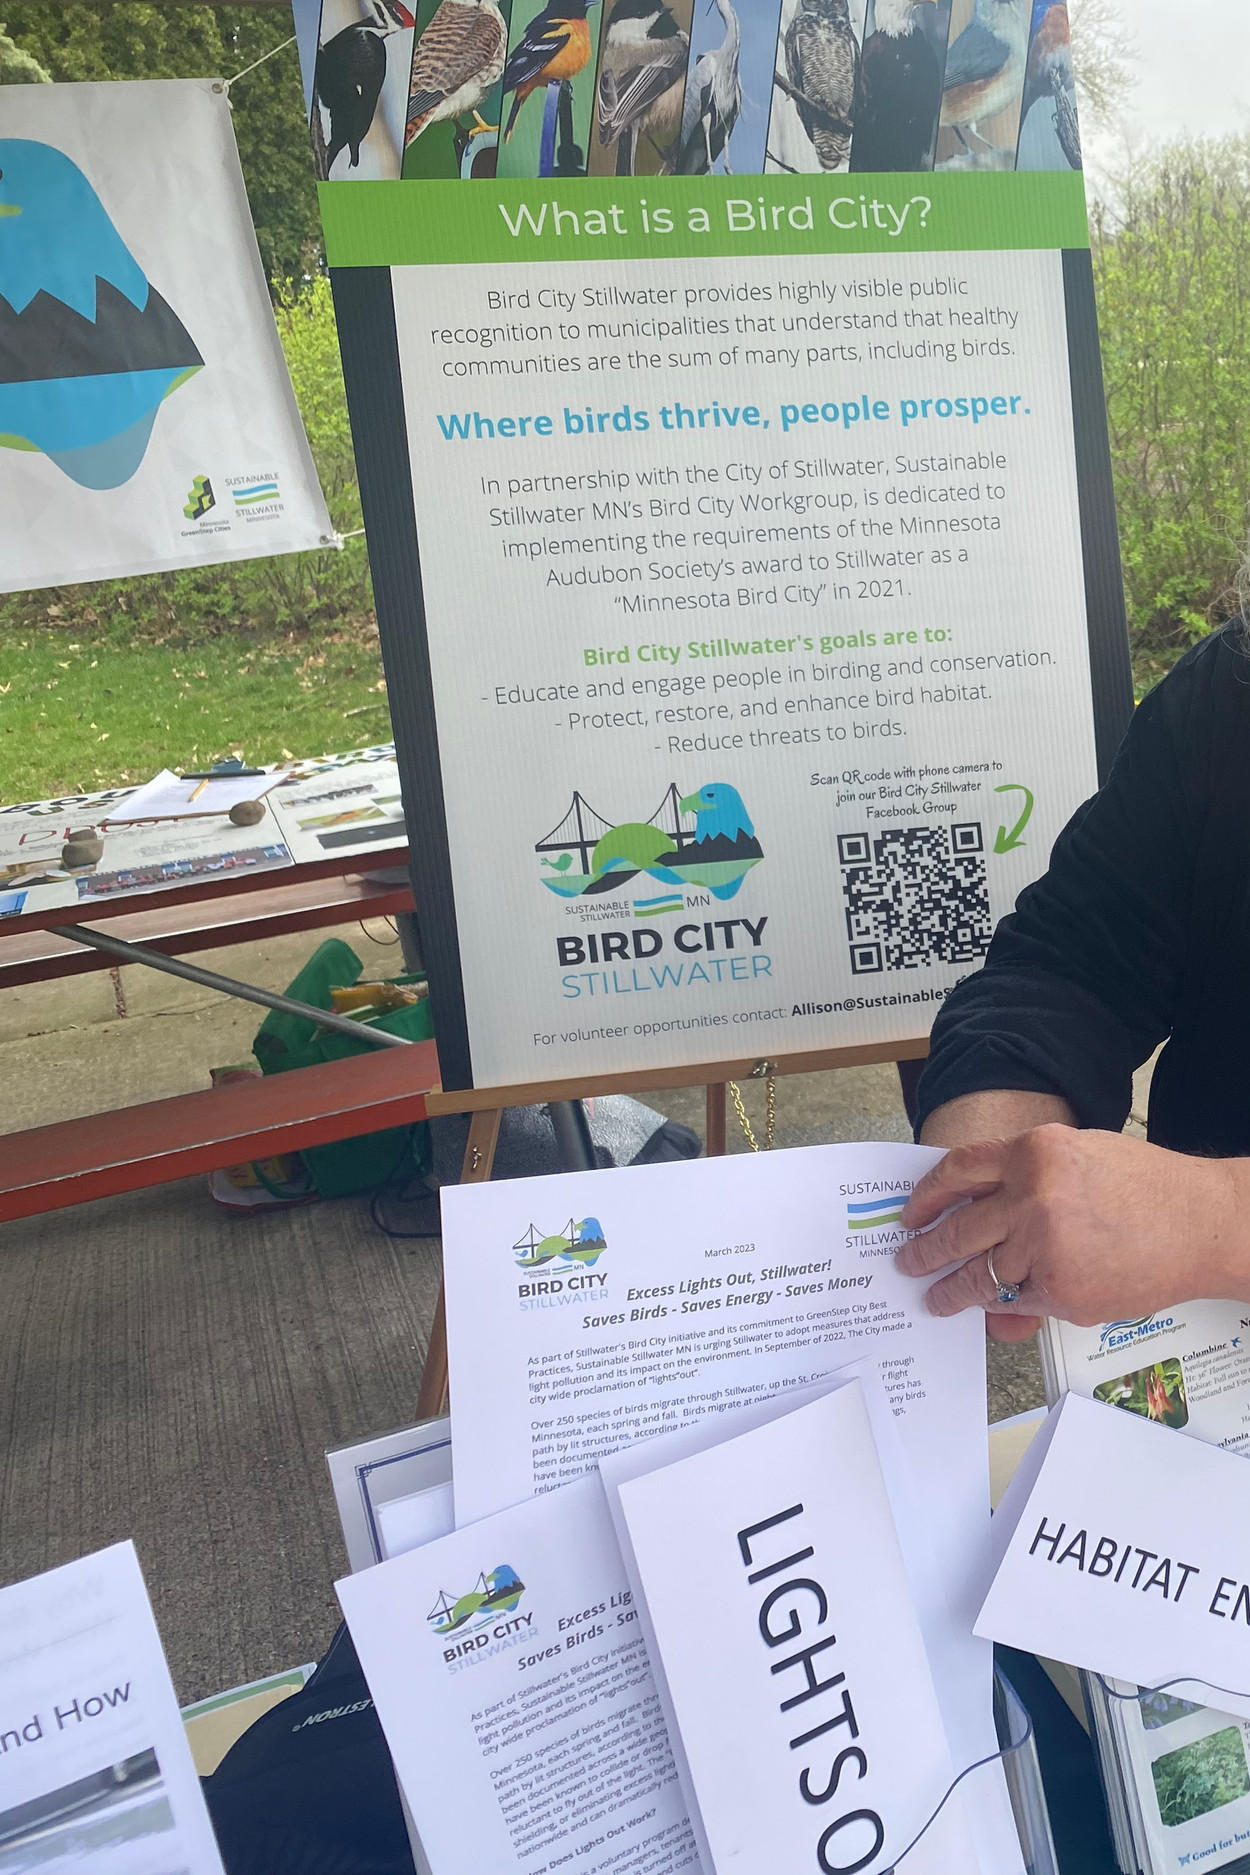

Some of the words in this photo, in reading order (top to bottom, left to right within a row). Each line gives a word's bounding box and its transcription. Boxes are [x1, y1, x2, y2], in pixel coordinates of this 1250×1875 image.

[498, 201, 627, 236] What
[640, 199, 673, 233] is
[687, 207, 710, 232] a
[726, 196, 813, 231] Bird
[828, 194, 931, 236] City?
[487, 289, 530, 309] Bird
[537, 289, 576, 312] City
[582, 286, 677, 306] Stillwater
[684, 282, 772, 308] provides
[778, 280, 836, 304] highly
[841, 278, 902, 297] visible
[909, 277, 967, 300] public
[436, 411, 552, 440] Where
[563, 404, 650, 434] birds
[658, 400, 769, 429] thrive,
[780, 394, 889, 432] people
[900, 395, 1030, 426] prosper.
[224, 472, 278, 486] SUSTAINABLE
[235, 504, 284, 516] STILLWATER
[583, 645, 630, 666] Bird
[637, 643, 680, 665] City
[687, 635, 813, 658] Stillwater's
[820, 629, 876, 654] goals
[883, 630, 917, 645] are
[923, 627, 952, 642] to:
[495, 683, 579, 704] Educate
[586, 676, 624, 697] and
[631, 675, 705, 697] engage
[712, 666, 781, 693] people
[788, 665, 805, 682] in
[812, 661, 882, 682] birding
[887, 656, 923, 676] and
[930, 649, 1056, 672] conservation.
[568, 709, 648, 730] Protect,
[655, 705, 733, 723] restore,
[740, 696, 777, 717] and
[784, 694, 869, 713] enhance
[875, 687, 914, 707] bird
[920, 684, 991, 703] habitat.
[668, 732, 743, 753] Reduce
[748, 727, 820, 746] threats
[825, 725, 846, 740] to
[852, 718, 906, 738] birds.
[810, 773, 839, 786] Scan
[842, 770, 864, 785] QR
[864, 768, 891, 781] code
[893, 766, 915, 778] with
[918, 764, 950, 780] phone
[952, 763, 989, 774] camera
[991, 760, 1002, 770] to
[835, 789, 855, 807] join
[858, 791, 876, 800] our
[878, 785, 902, 799] Bird
[904, 783, 928, 800] City
[930, 781, 981, 794] Stillwater
[865, 802, 920, 818] Facebook
[922, 801, 957, 815] Group
[565, 900, 629, 915] SUSTAINABLE
[686, 894, 710, 907] MN
[580, 910, 630, 922] STILLWATER
[556, 928, 663, 966] BIRD
[673, 916, 768, 953] CITY
[561, 954, 772, 998] STILLWATER
[533, 1033, 556, 1045] For
[560, 1026, 628, 1042] volunteer
[633, 1015, 728, 1036] opportunities
[732, 1007, 788, 1024] contact:
[791, 984, 955, 1016] Allison@SustainableS
[704, 1247, 732, 1257] March
[734, 1243, 755, 1253] 2023
[518, 1280, 563, 1297] BIRD
[567, 1272, 607, 1290] CITY
[626, 1285, 674, 1301] Excess
[679, 1277, 722, 1294] Lights
[726, 1271, 755, 1285] Out,
[760, 1258, 831, 1280] Stillwater!
[519, 1288, 608, 1310] STILLWATER
[582, 1313, 625, 1328] Saves
[630, 1304, 667, 1321] Birds
[680, 1298, 721, 1313] Saves
[725, 1290, 773, 1306] Energy
[785, 1282, 823, 1297] Saves
[827, 1275, 872, 1290] Money
[1108, 1317, 1173, 1346] East-Metro
[1182, 1342, 1226, 1362] Columbine
[1028, 1516, 1200, 1602] HABITAT
[558, 1602, 605, 1631] Excess
[610, 1590, 633, 1608] Lig
[518, 1644, 561, 1670] Saves
[566, 1625, 603, 1649] Birds
[0, 1714, 43, 1750] nd
[54, 1681, 131, 1730] How
[301, 1699, 375, 1728] ESTRON
[1192, 1843, 1217, 1860] Good
[1218, 1839, 1232, 1849] for
